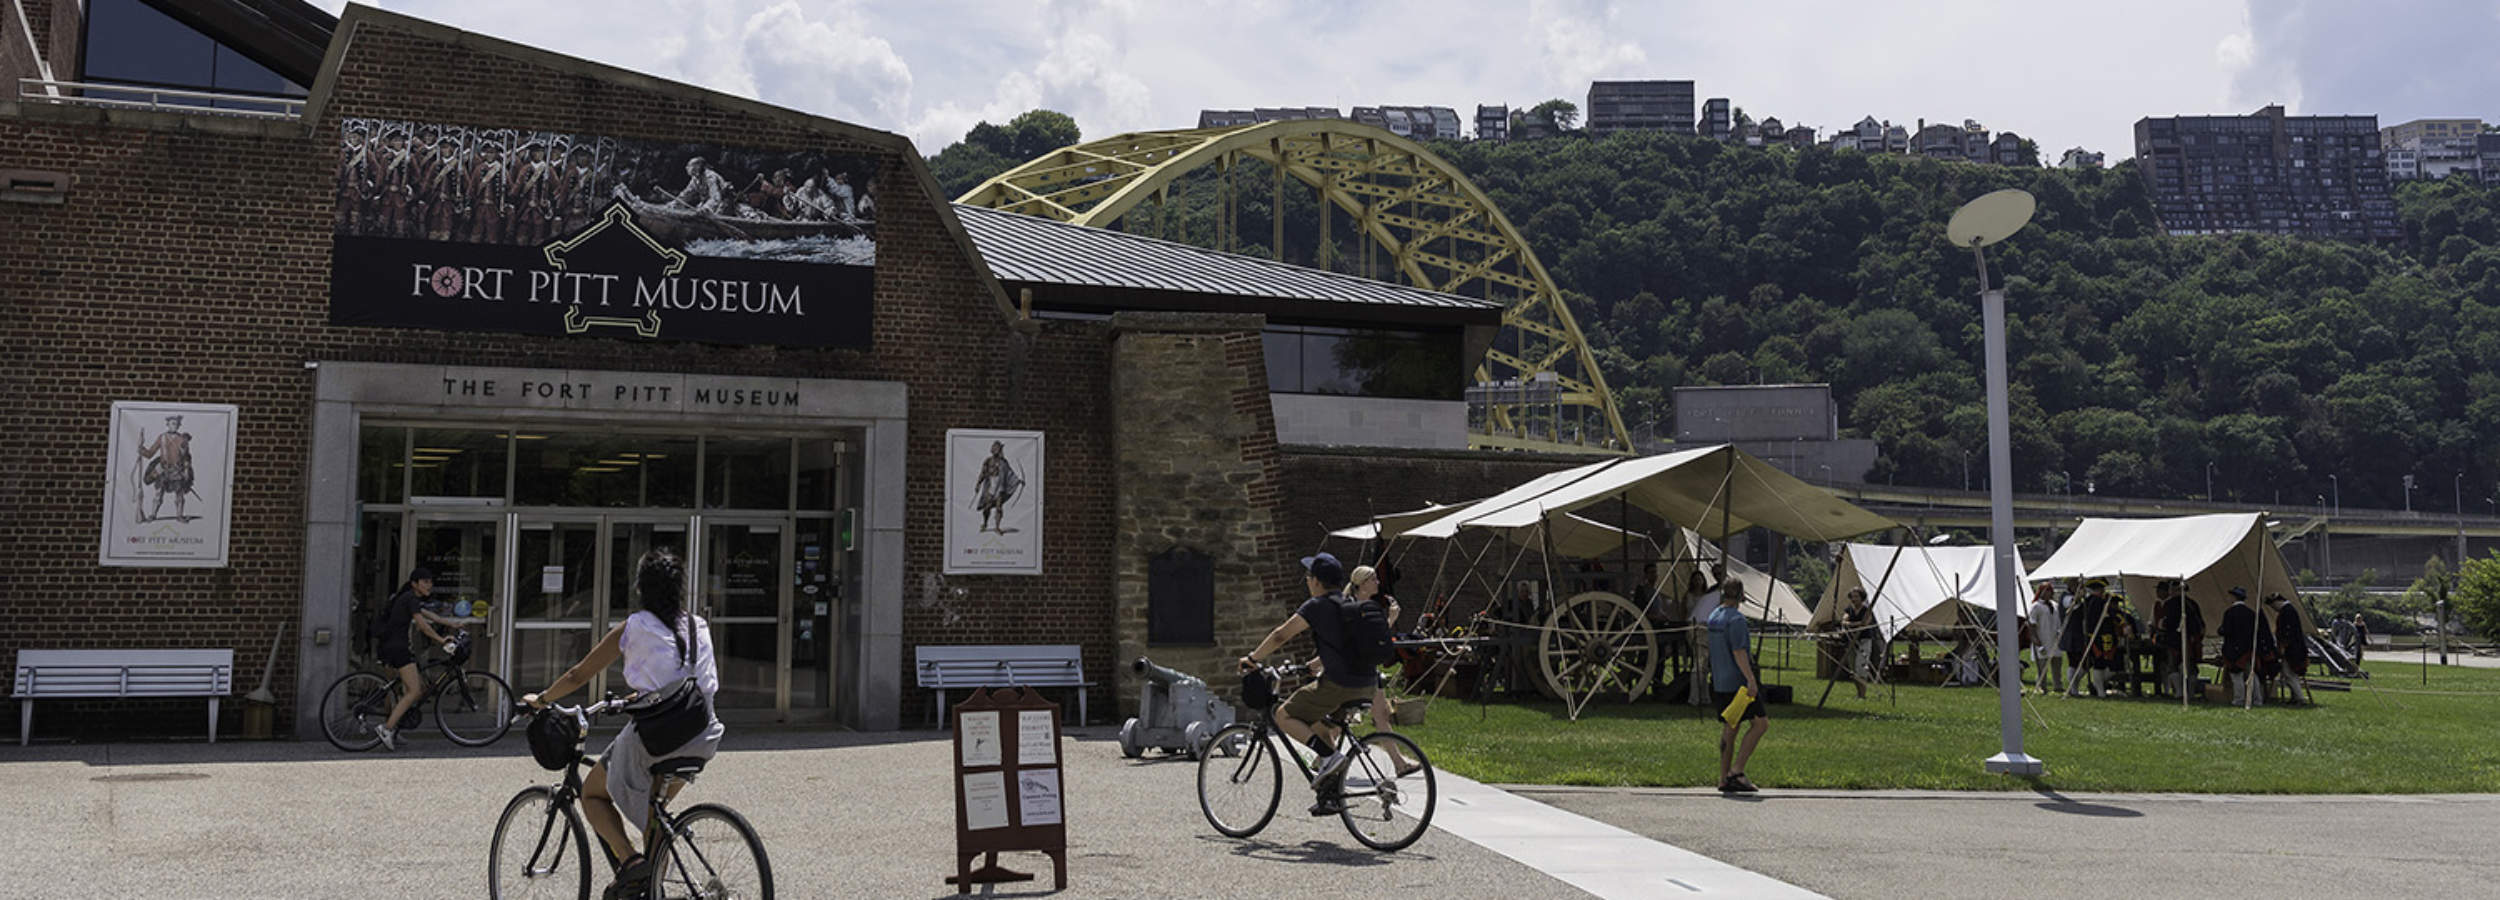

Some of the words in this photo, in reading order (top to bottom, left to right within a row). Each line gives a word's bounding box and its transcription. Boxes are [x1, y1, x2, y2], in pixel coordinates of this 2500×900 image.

[412, 263, 513, 300] FORT
[528, 269, 619, 306] PITT
[632, 275, 805, 316] MUSEUM
[443, 378, 495, 396] THE
[521, 381, 591, 399] FORT
[615, 385, 671, 401] PITT
[695, 388, 799, 406] MUSEUM
